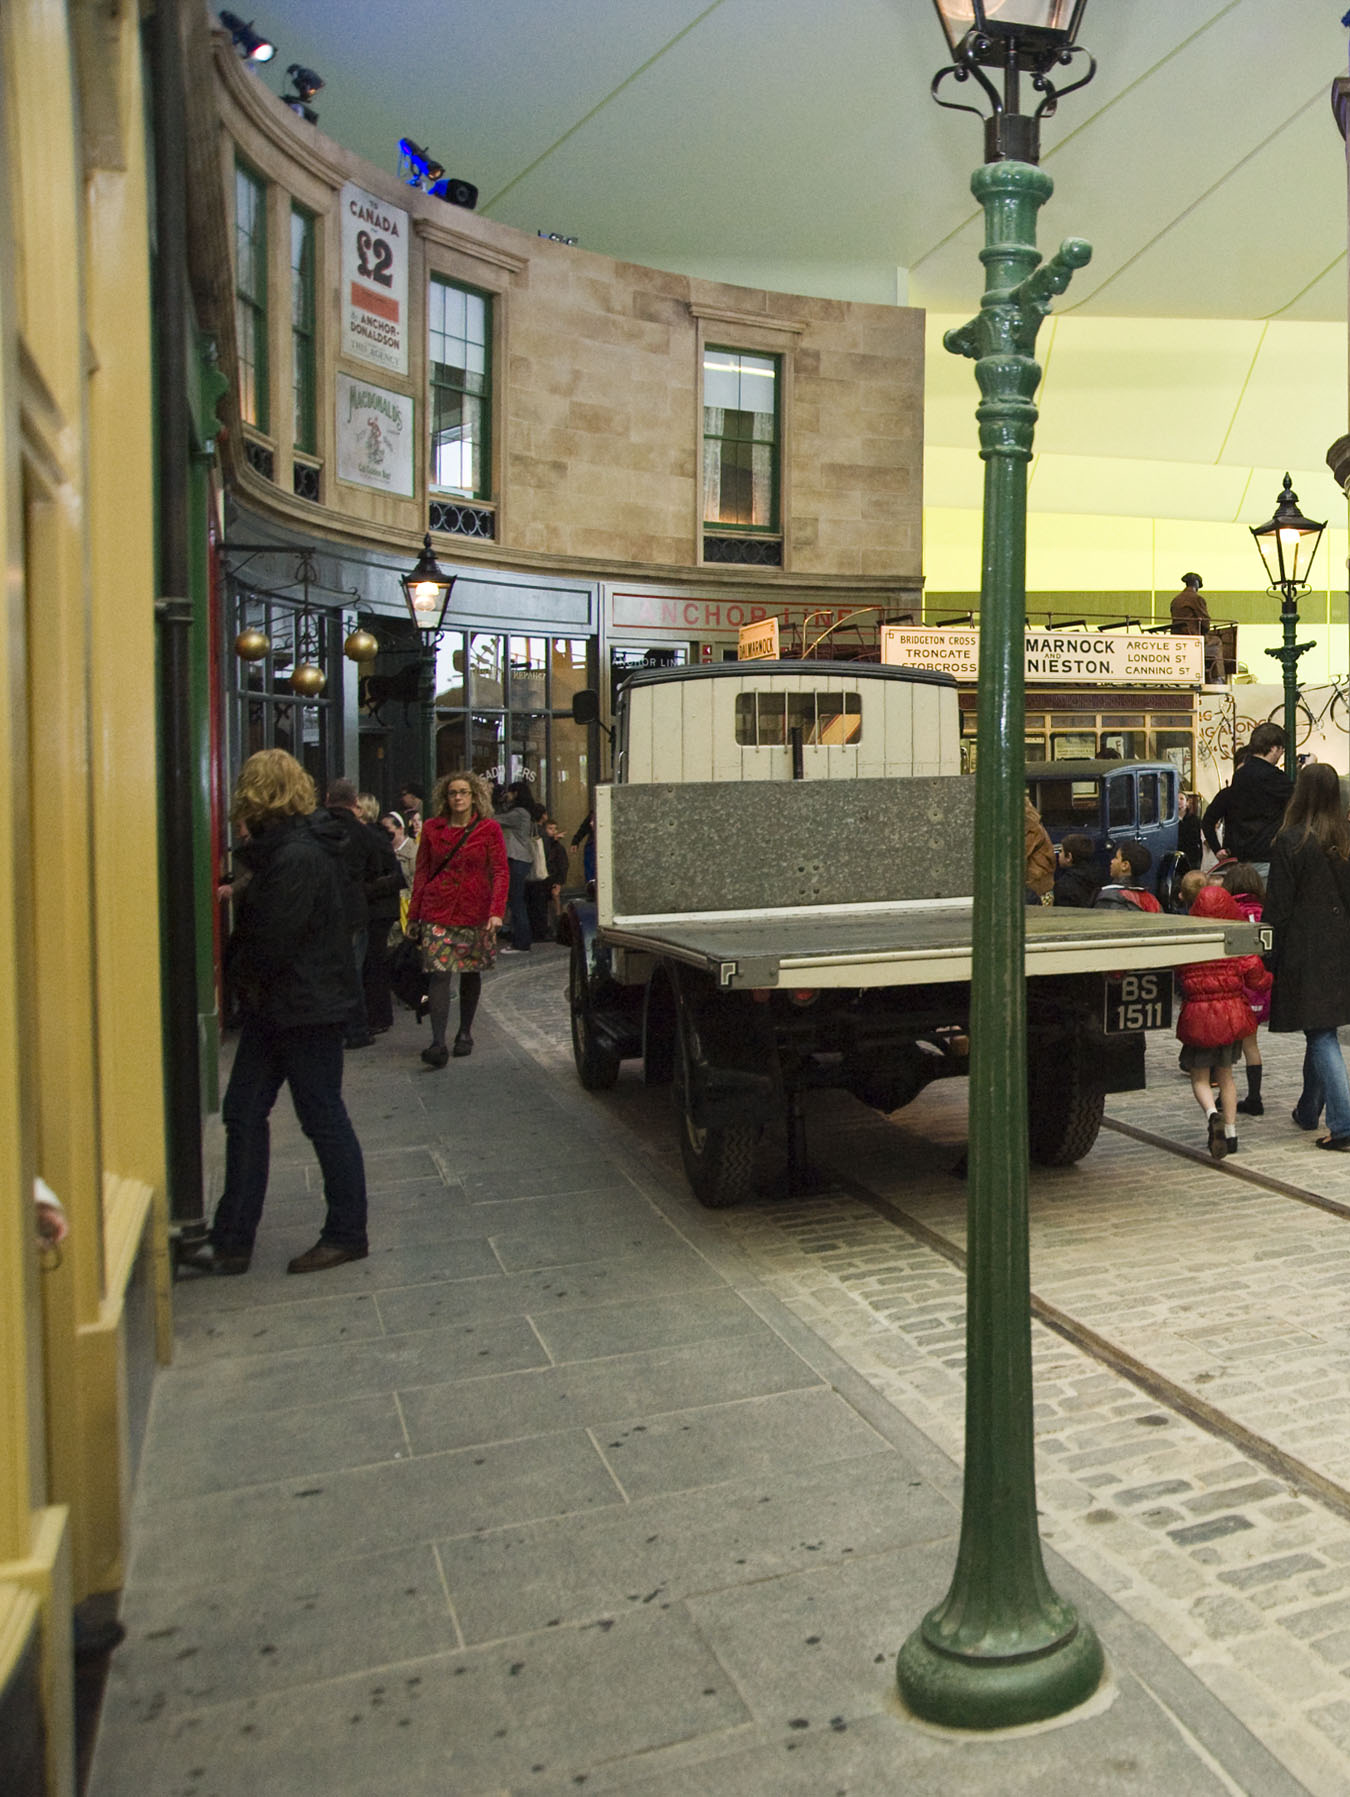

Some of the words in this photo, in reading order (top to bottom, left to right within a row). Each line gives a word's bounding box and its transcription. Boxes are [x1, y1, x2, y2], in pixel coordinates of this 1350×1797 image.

[349, 200, 400, 238] CANADA
[356, 230, 393, 288] £2
[350, 320, 400, 350] DONALDSON
[639, 602, 768, 627] ANCHOR
[900, 634, 945, 645] BRIDGETON
[948, 636, 976, 646] CROSS
[1025, 638, 1115, 654] MARNOCK
[1126, 641, 1170, 651] ARGYLE
[905, 648, 971, 659] TRONGATE
[1044, 652, 1061, 660] AND
[1127, 653, 1170, 663] LONDON
[1027, 659, 1114, 674] NIESTON.
[1125, 666, 1173, 675] CANNING
[1121, 974, 1159, 1002] BS
[1117, 1001, 1163, 1030] 1511
